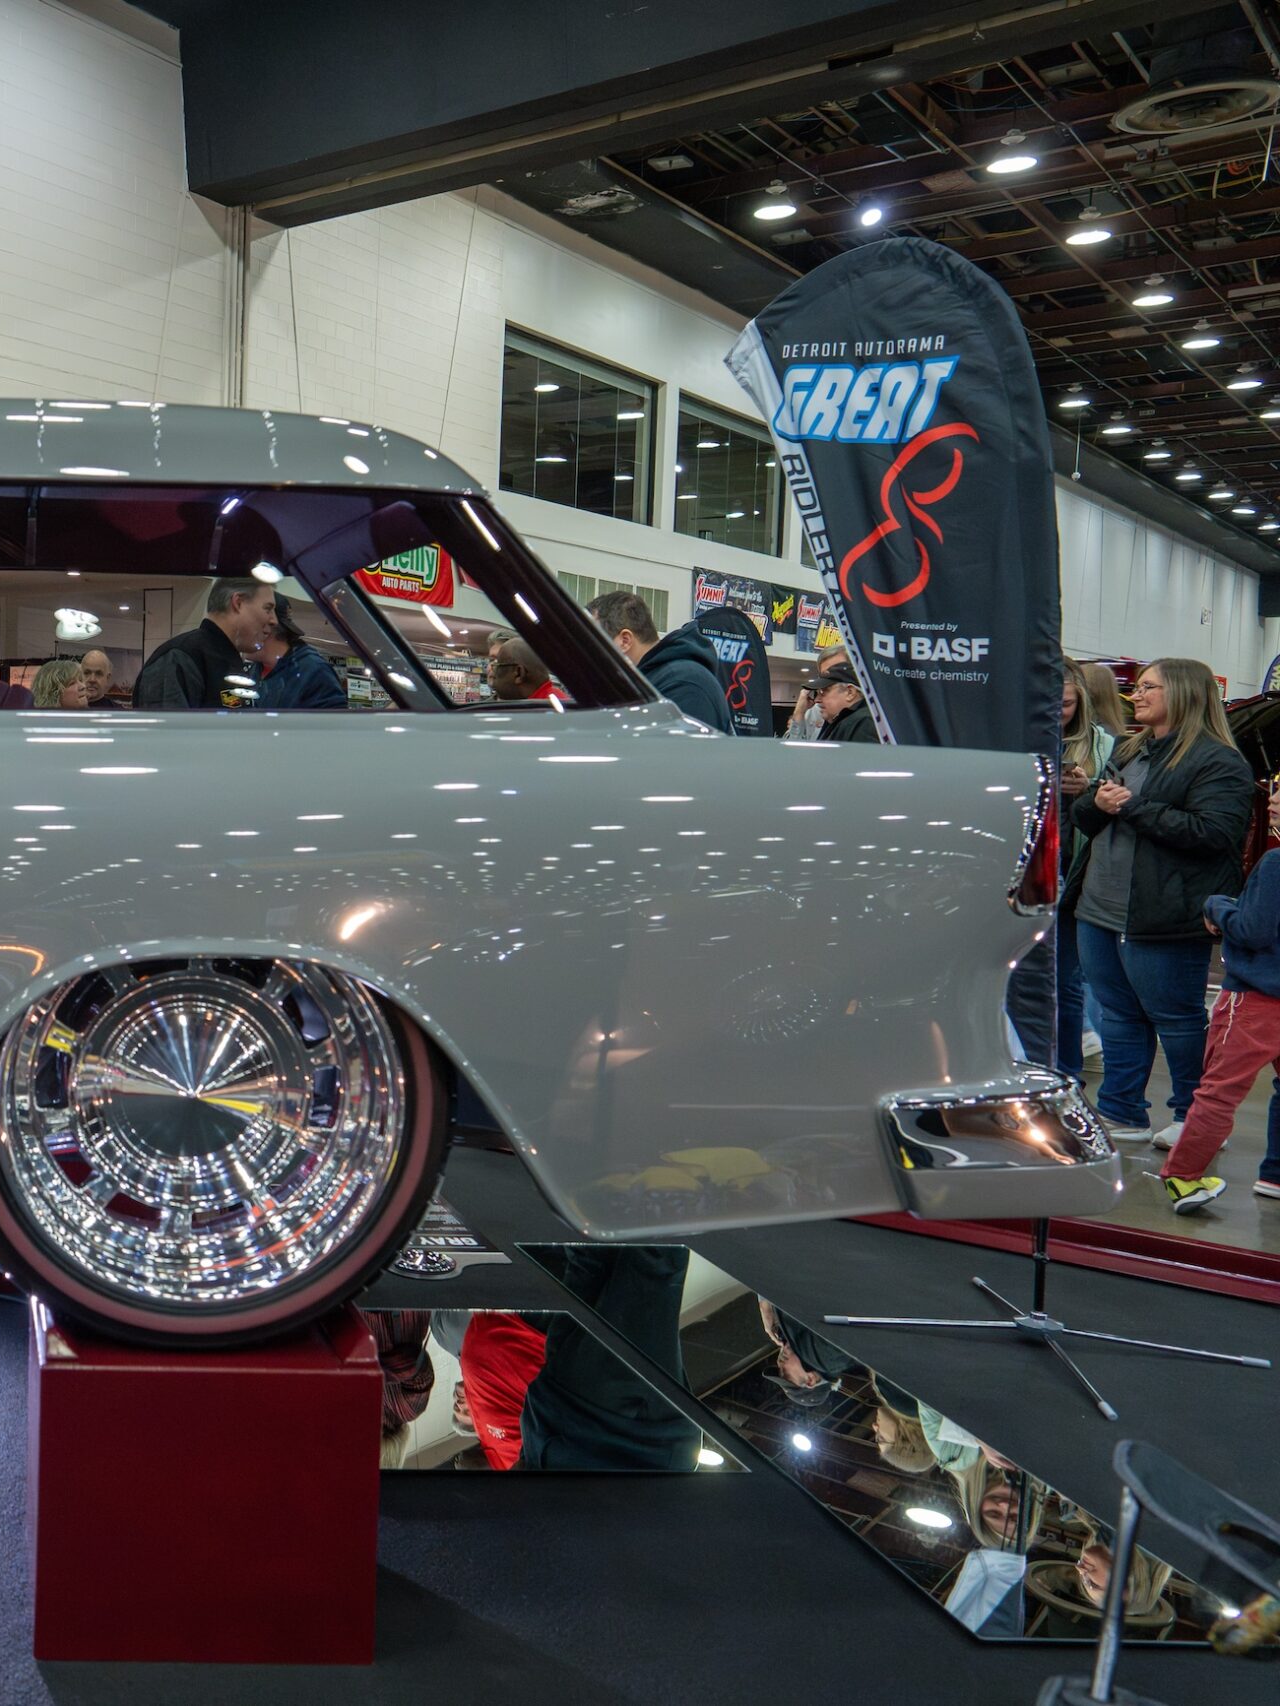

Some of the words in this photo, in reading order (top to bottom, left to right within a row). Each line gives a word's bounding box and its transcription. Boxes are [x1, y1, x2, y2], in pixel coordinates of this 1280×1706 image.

[782, 342, 847, 359] DETROIT
[855, 335, 945, 356] AUTORAMA
[773, 356, 959, 443] GREAT
[782, 453, 838, 576] RIDLER
[382, 576, 399, 589] AUTO
[399, 579, 420, 593] PARTS
[900, 621, 945, 631] Presented
[946, 622, 958, 633] by
[910, 636, 990, 663] BASF
[873, 660, 891, 675] We
[894, 668, 926, 680] create
[930, 669, 989, 684] chemistry
[420, 1236, 478, 1246] GRAY
